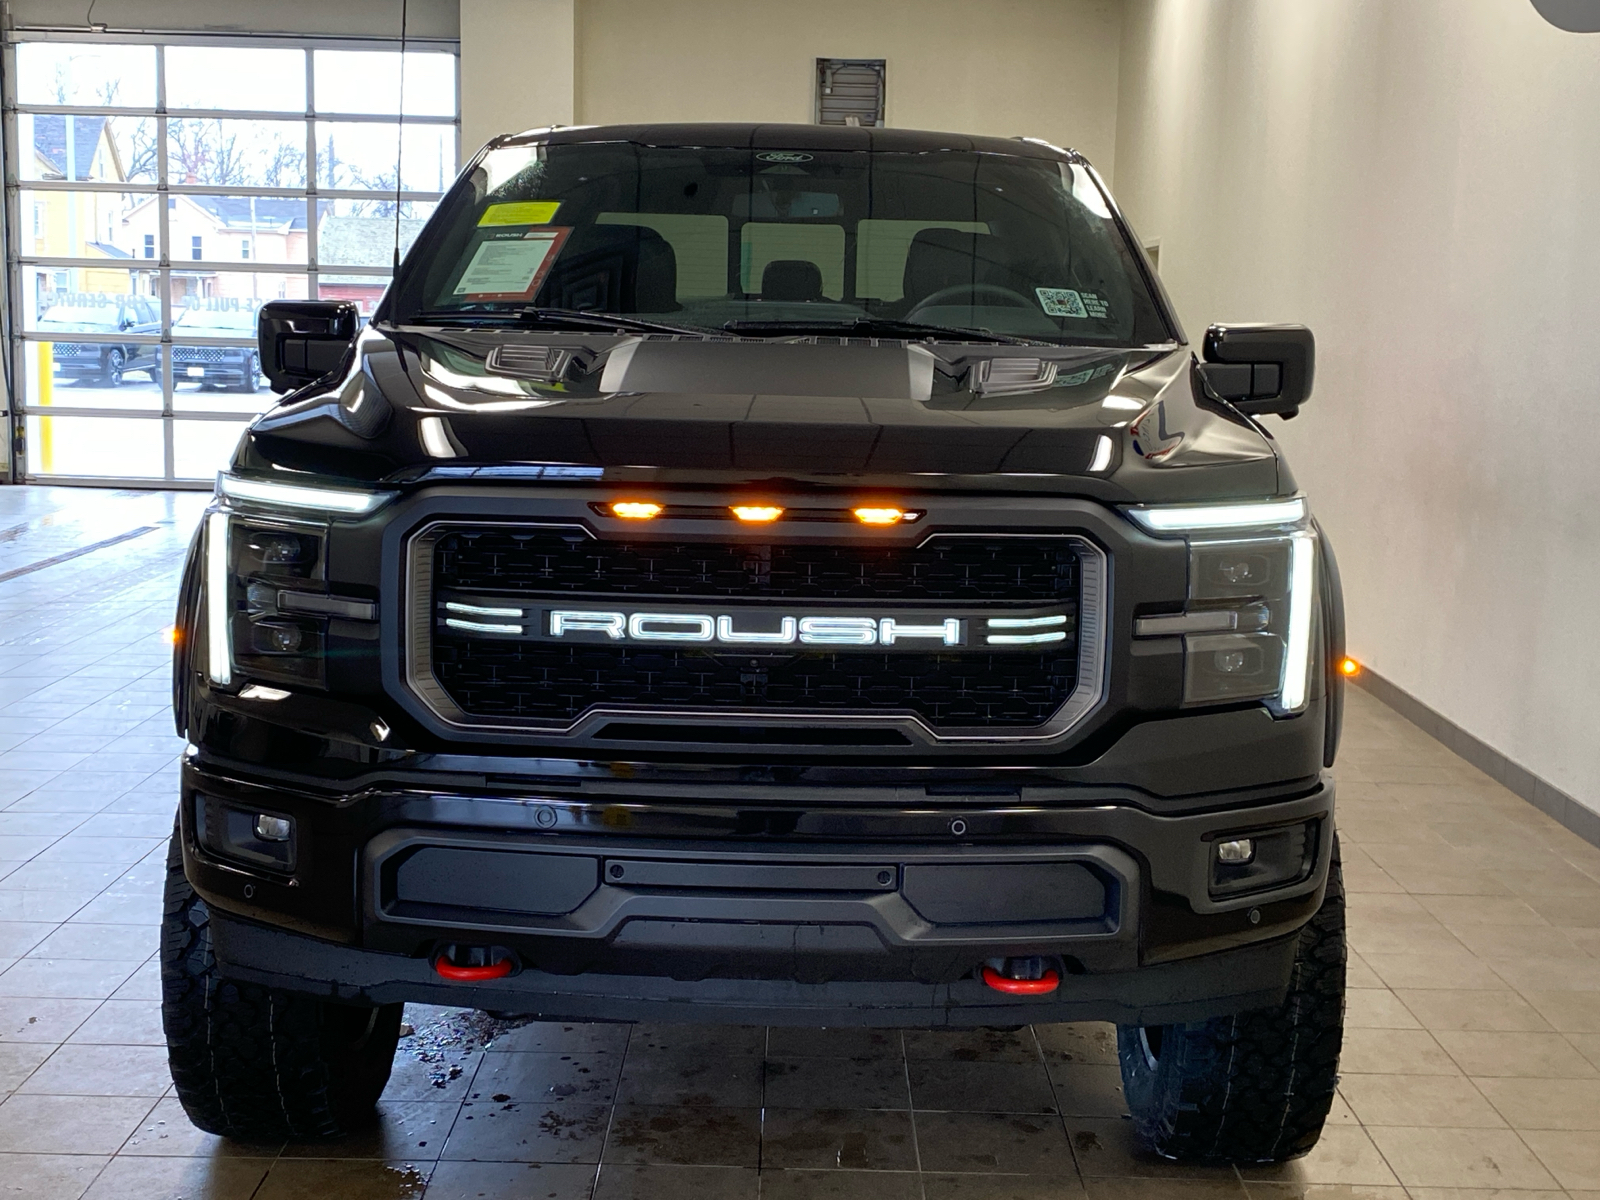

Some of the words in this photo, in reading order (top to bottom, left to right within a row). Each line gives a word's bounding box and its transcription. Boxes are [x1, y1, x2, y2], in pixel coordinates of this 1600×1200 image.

[766, 153, 804, 161] Ford
[1083, 298, 1100, 306] HERE
[1086, 304, 1107, 312] LEARN
[549, 609, 962, 646] ROUSH
